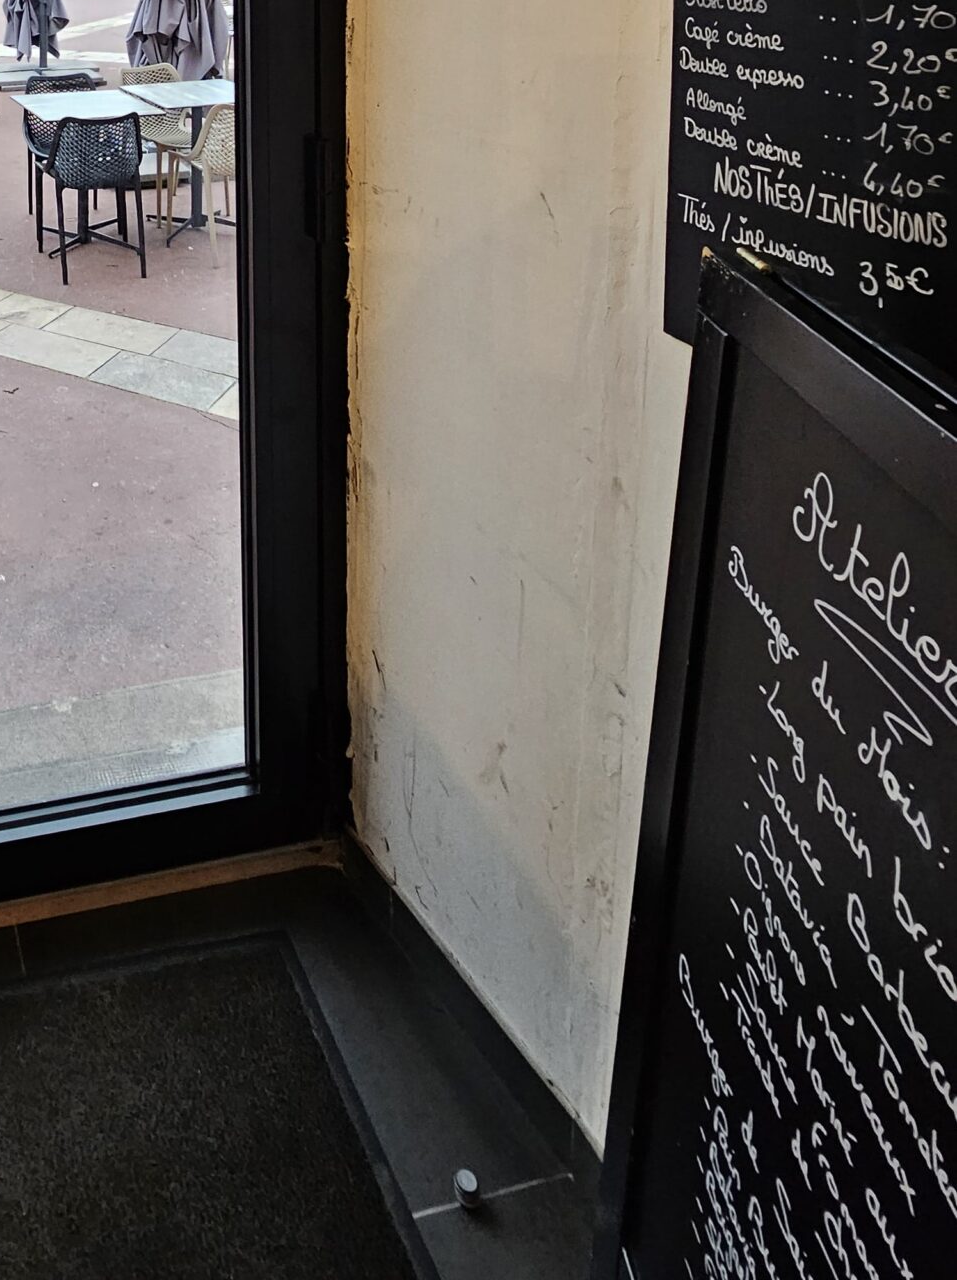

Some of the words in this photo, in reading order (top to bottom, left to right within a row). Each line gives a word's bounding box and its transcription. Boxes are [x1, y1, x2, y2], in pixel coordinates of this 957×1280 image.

[680, 46, 729, 78] Double
[737, 65, 804, 89] expresso
[685, 17, 719, 50] Café
[726, 23, 784, 51] crème
[684, 117, 737, 150] Double
[746, 133, 803, 168] crème
[686, 87, 746, 126] Allongé
[714, 156, 752, 199] NOS
[677, 193, 715, 232] Thés
[732, 216, 834, 276] infusions
[728, 546, 799, 664] Burger
[812, 661, 846, 734] du
[759, 757, 824, 886] Sauce
[817, 774, 872, 878] pain
[679, 954, 733, 1097] Burger
[742, 1111, 759, 1173] de
[737, 963, 797, 1104] Sauce
[797, 1016, 857, 1166] Mariné
[817, 1006, 915, 1215] nouveaux
[714, 1106, 741, 1191] Pain
[792, 1129, 811, 1190] de
